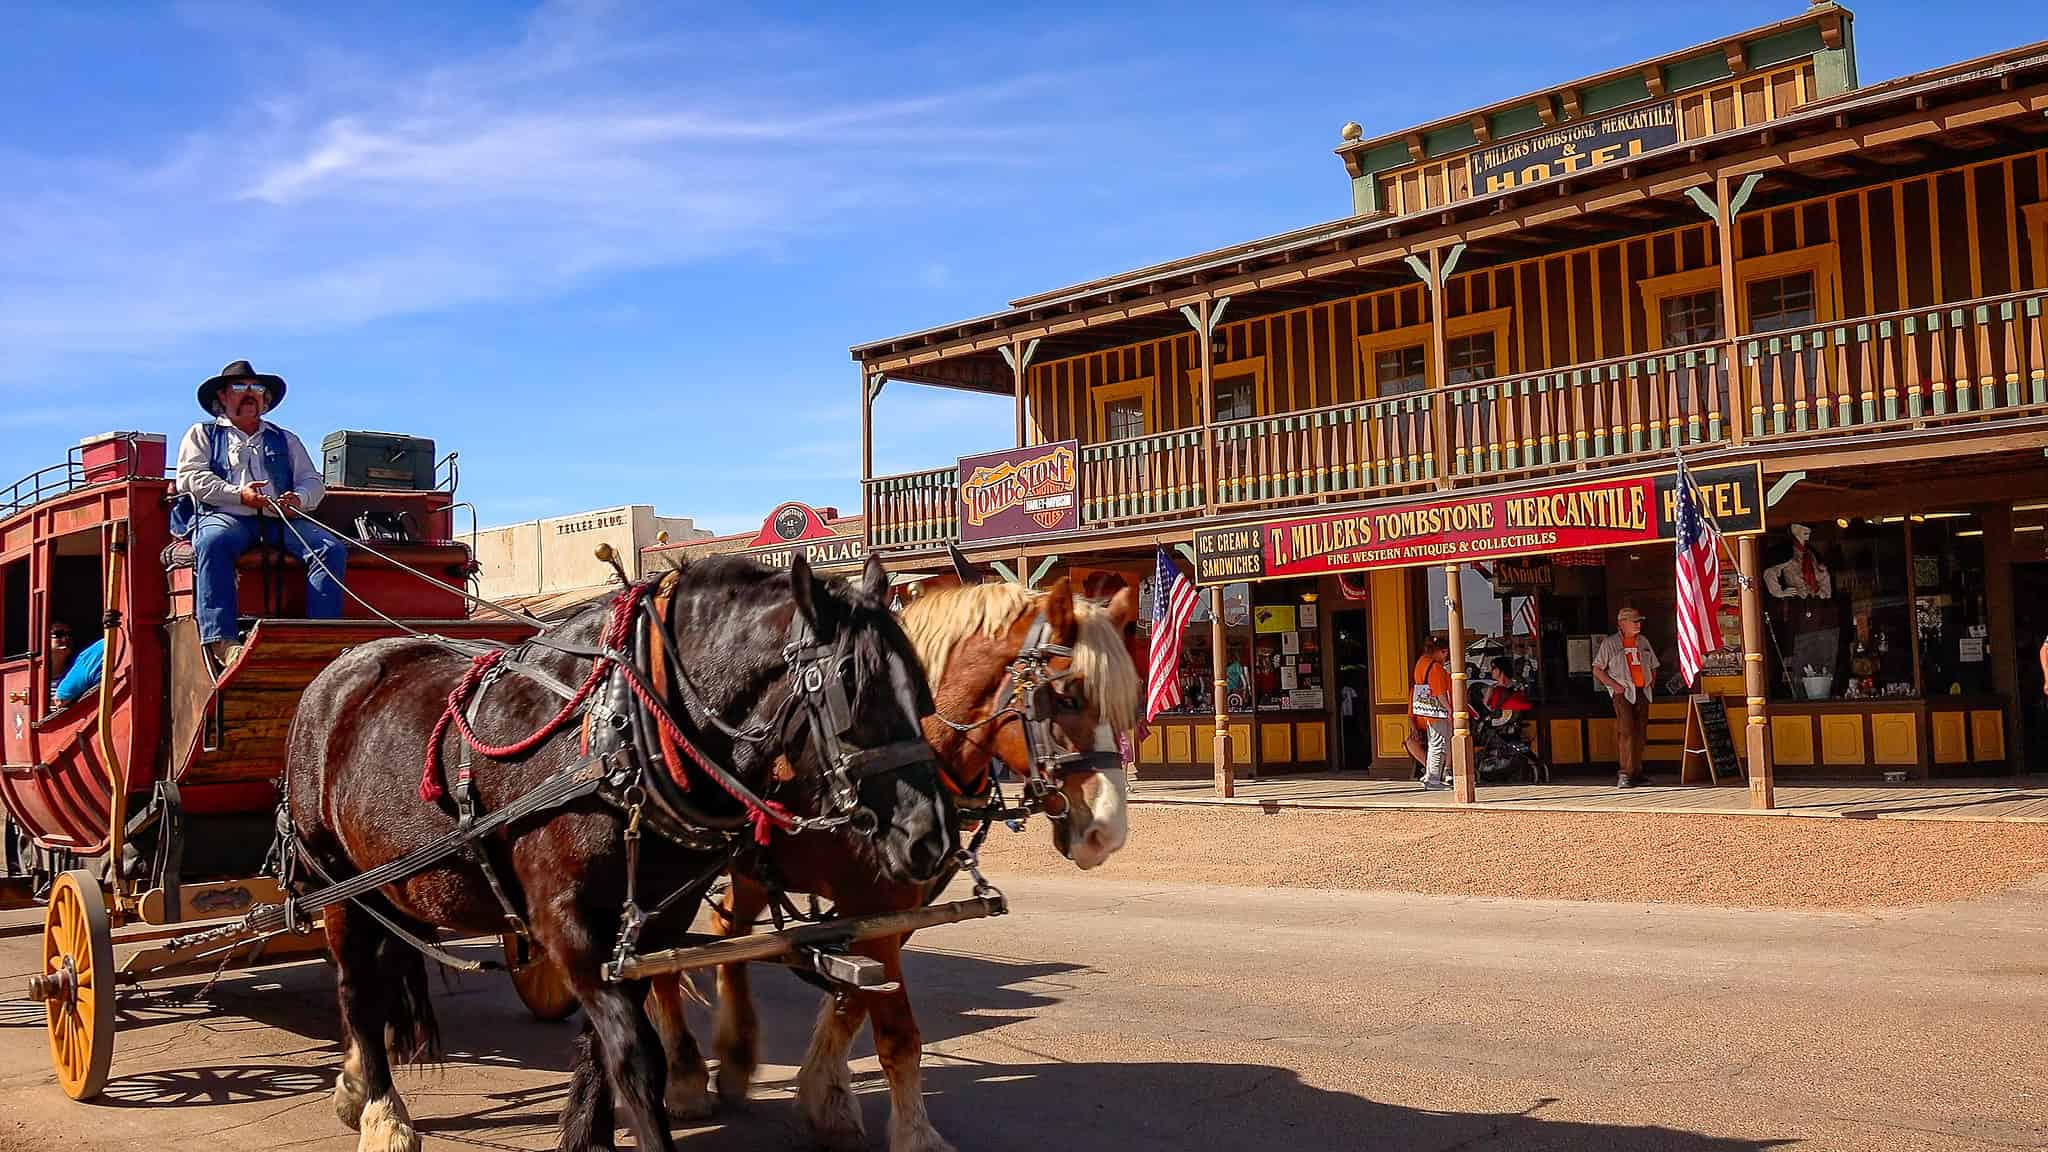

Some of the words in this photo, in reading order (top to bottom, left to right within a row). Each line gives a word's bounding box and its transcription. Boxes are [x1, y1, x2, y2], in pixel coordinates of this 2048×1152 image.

[1472, 155, 1483, 174] T.
[1484, 139, 1530, 171] MILLER'S
[1530, 123, 1596, 153] TOMBSTONE
[1601, 103, 1674, 135] MERCANTILE
[1562, 143, 1577, 156] &
[966, 451, 1071, 521] TOMBSTONE
[1663, 482, 1751, 522] HTEL
[1199, 535, 1215, 554] ICE
[1217, 531, 1249, 552] CREAM
[1252, 530, 1260, 548] &
[1271, 527, 1287, 567] T.
[1290, 516, 1371, 562] MILLER'S
[1374, 501, 1495, 541] TOMBSTONE
[1505, 485, 1647, 530] MERCANTILE
[1202, 554, 1261, 578] SANDWICHES
[1327, 554, 1349, 566] FINE
[1352, 547, 1401, 563] WESTERN
[1404, 542, 1457, 559] ANTIQUES
[1459, 541, 1469, 552] &
[1471, 532, 1557, 551] COLLECTIBLES
